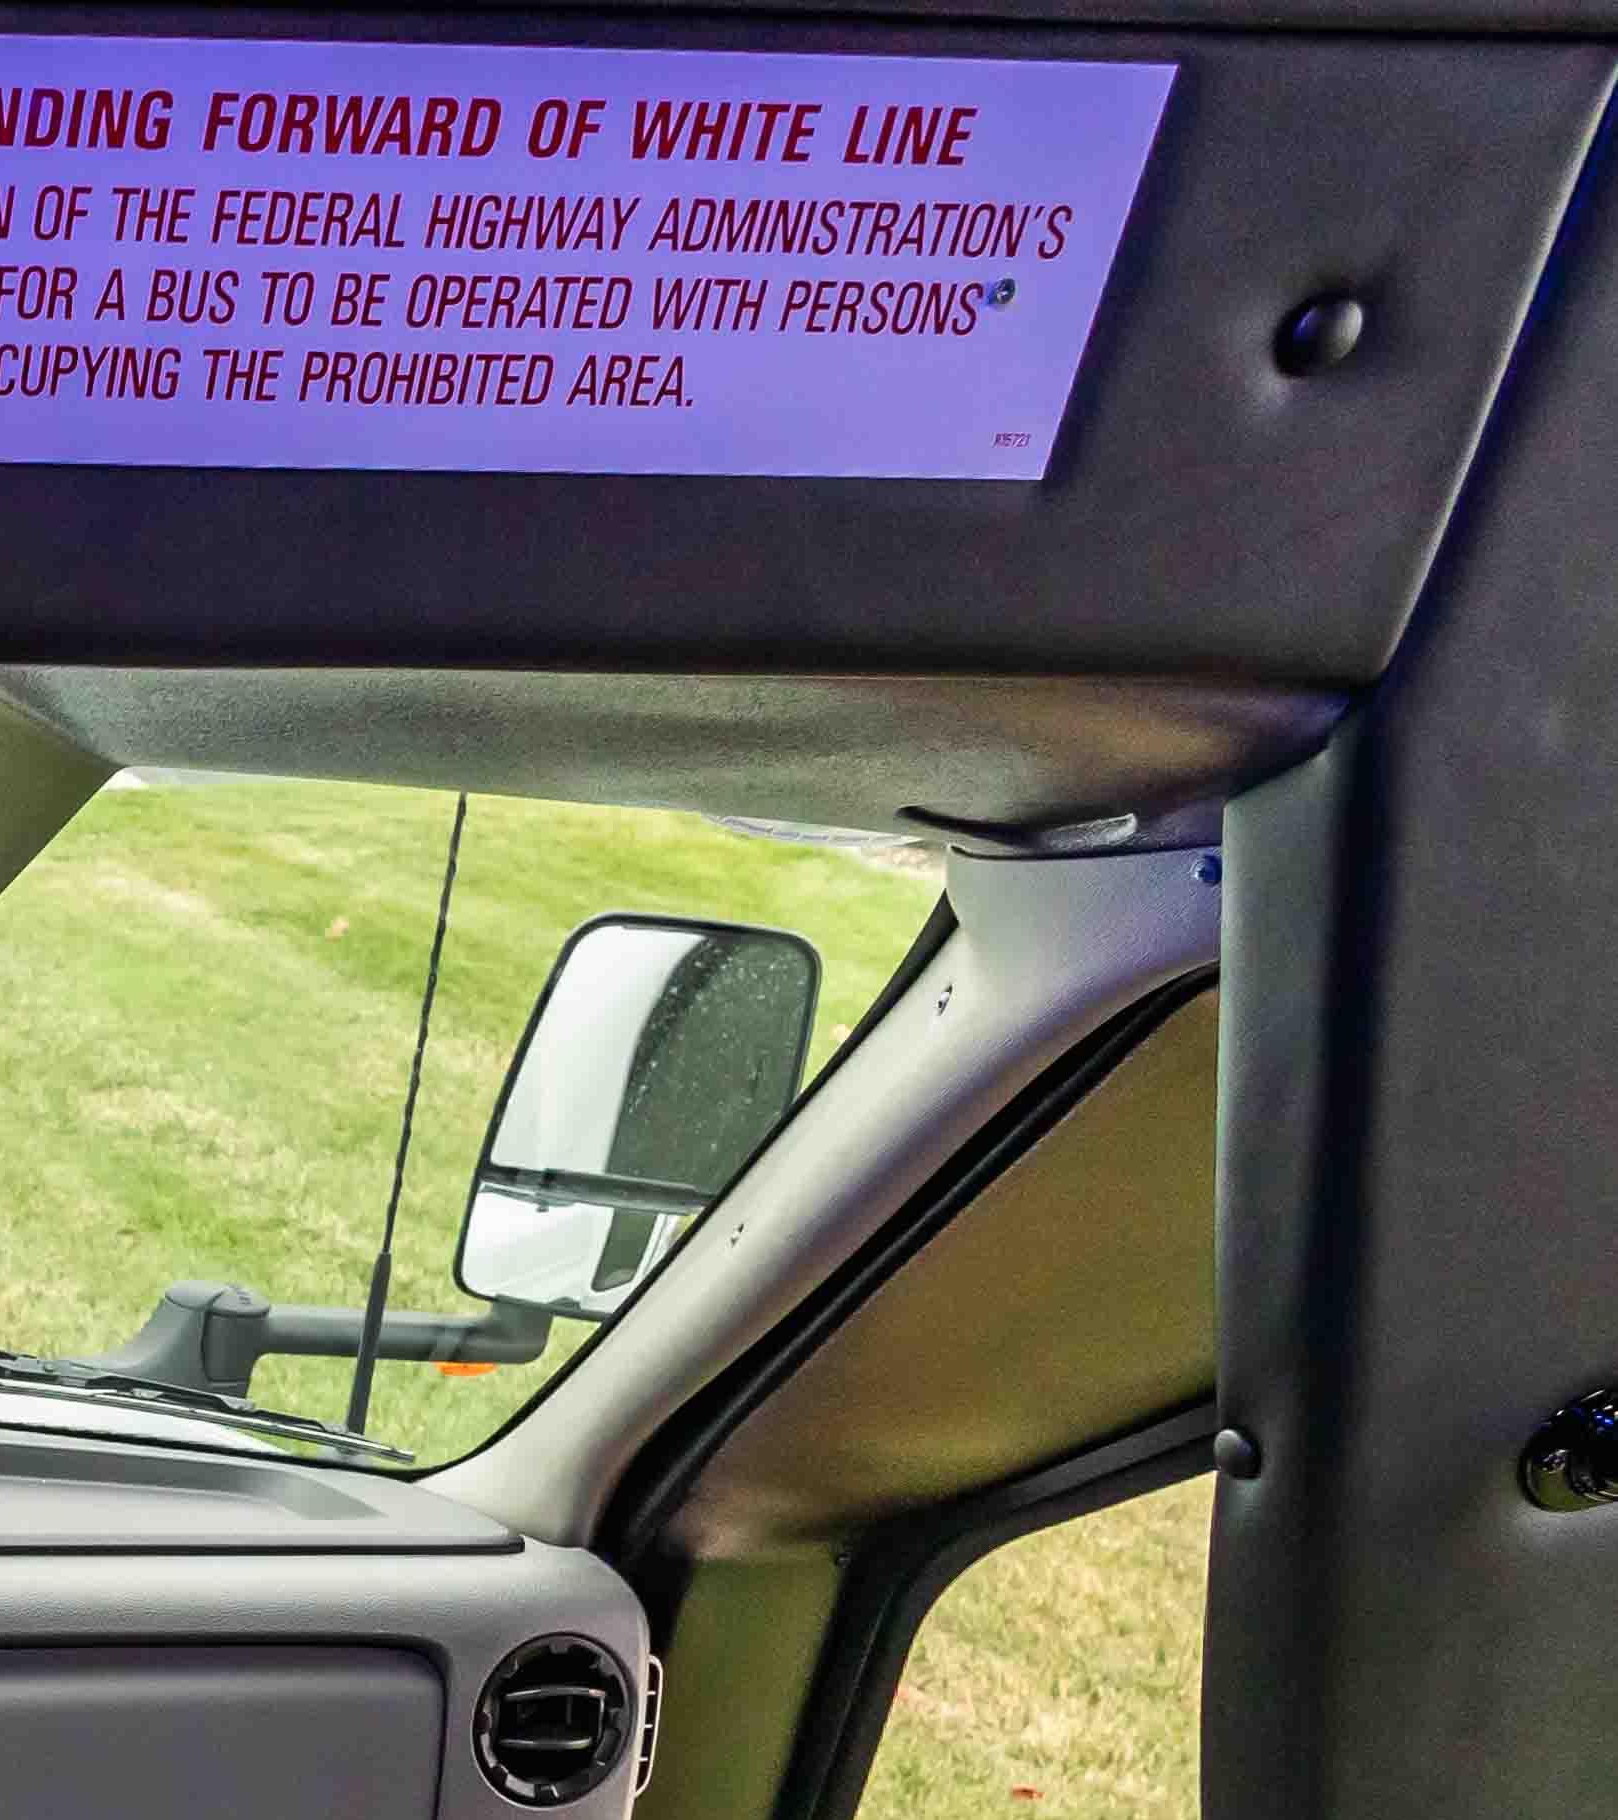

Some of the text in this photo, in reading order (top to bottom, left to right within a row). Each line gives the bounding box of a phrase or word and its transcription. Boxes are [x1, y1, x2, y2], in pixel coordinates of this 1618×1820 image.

[202, 91, 502, 158] FORWARD
[527, 98, 606, 159] OF
[631, 100, 822, 162] WHITE
[843, 104, 978, 165] LINE
[33, 185, 92, 241] OF
[112, 187, 196, 244] THE
[212, 189, 406, 249] FEDERAL
[424, 194, 639, 251] HIGHWAY
[648, 197, 1073, 260] ADMINISTRATION'S
[95, 268, 126, 321] A
[145, 269, 239, 325] BUS
[261, 272, 315, 326] TO
[331, 273, 391, 327] BE
[406, 274, 633, 330] OPERATED
[652, 278, 768, 331] WITH
[778, 280, 984, 336] PERSONS
[203, 348, 284, 402] THE
[299, 351, 555, 407] PROHIBITED
[567, 353, 694, 407] AREA.
